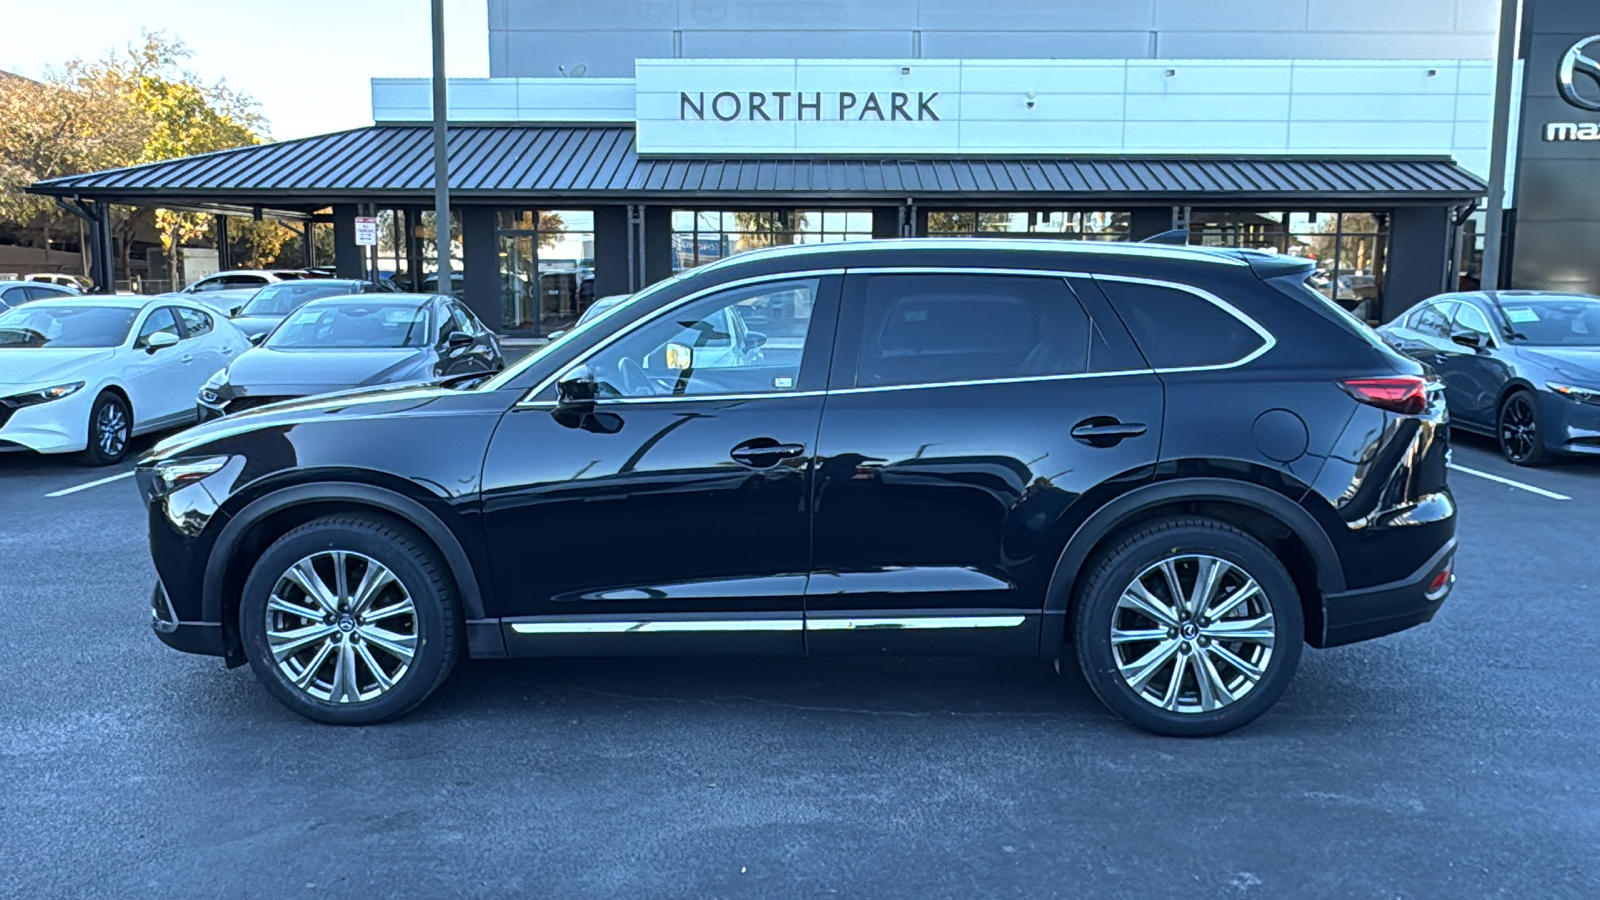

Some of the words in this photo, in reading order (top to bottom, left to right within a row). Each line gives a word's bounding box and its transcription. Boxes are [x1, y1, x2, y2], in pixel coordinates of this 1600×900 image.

[680, 91, 821, 121] NORTH
[839, 91, 940, 121] PARK
[1546, 122, 1600, 140] ma
